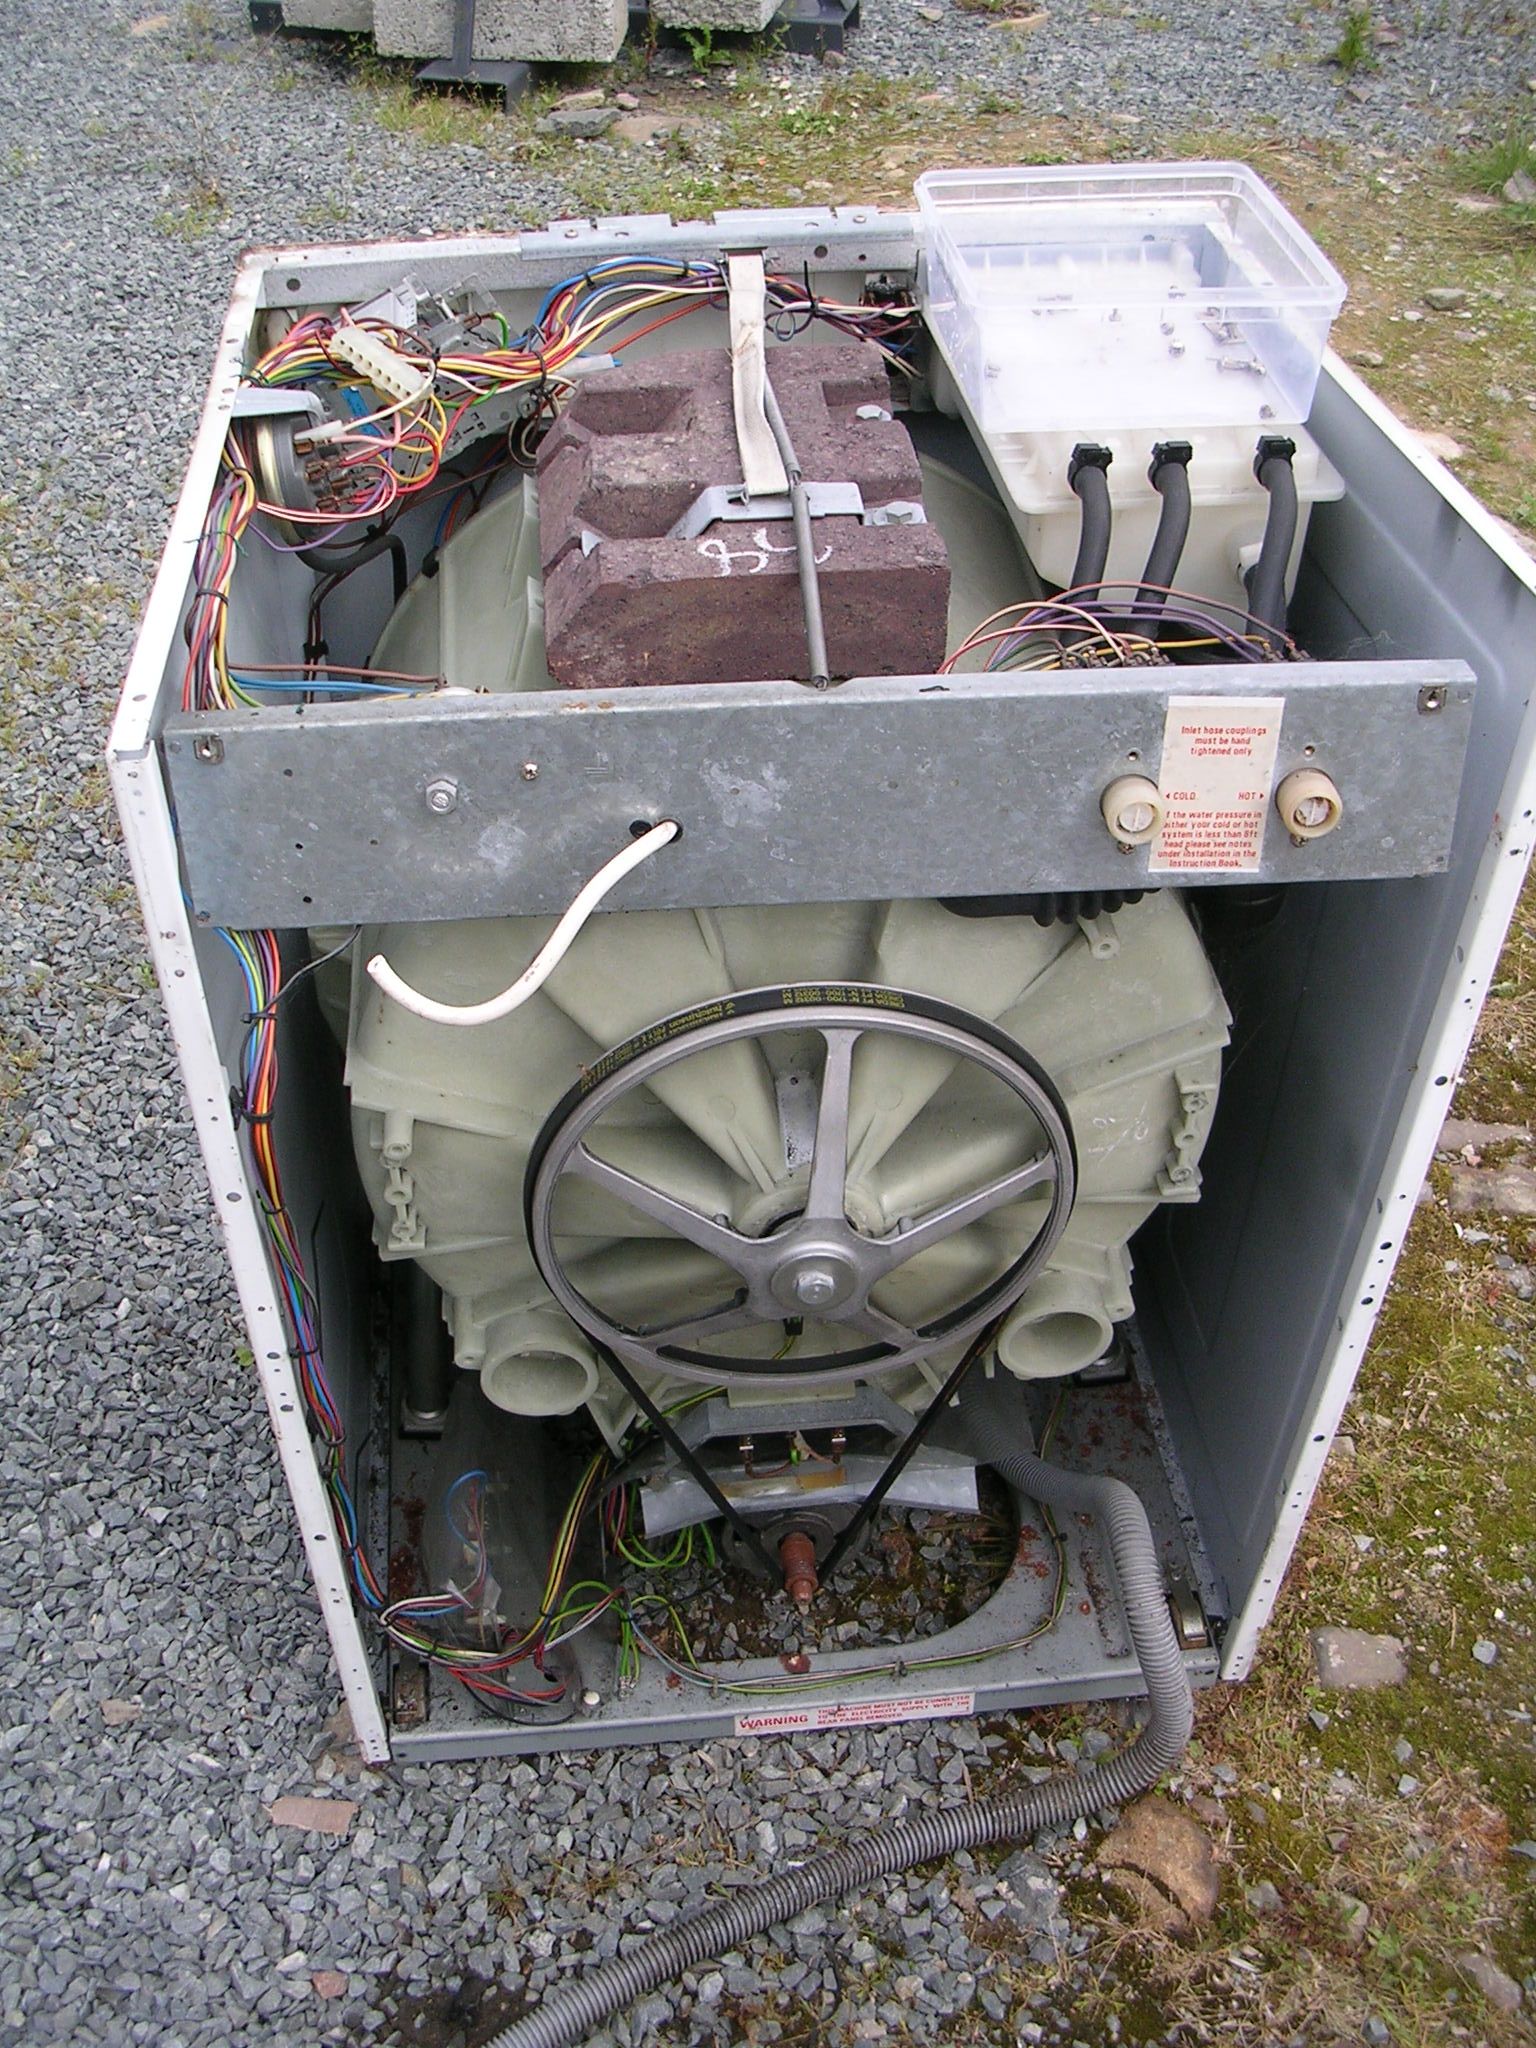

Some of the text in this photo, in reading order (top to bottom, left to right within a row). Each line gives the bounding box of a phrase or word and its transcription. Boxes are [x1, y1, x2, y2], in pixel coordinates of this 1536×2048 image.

[1181, 726, 1267, 737] Inlet hose couplings
[1231, 737, 1251, 745] hand
[1190, 747, 1252, 757] tightened only
[1173, 792, 1196, 800] COLD
[1238, 792, 1256, 800] HOT
[1173, 811, 1186, 819] the
[1189, 811, 1213, 819] water
[1253, 811, 1262, 819] in
[1191, 822, 1210, 830] your
[1212, 821, 1230, 829] cold
[1243, 821, 1258, 829] hot
[1162, 831, 1193, 839] system
[1184, 840, 1211, 850] please
[1157, 850, 1257, 858] under installation in the
[1169, 860, 1217, 868] Instruction
[740, 1715, 808, 1729] WARNING
